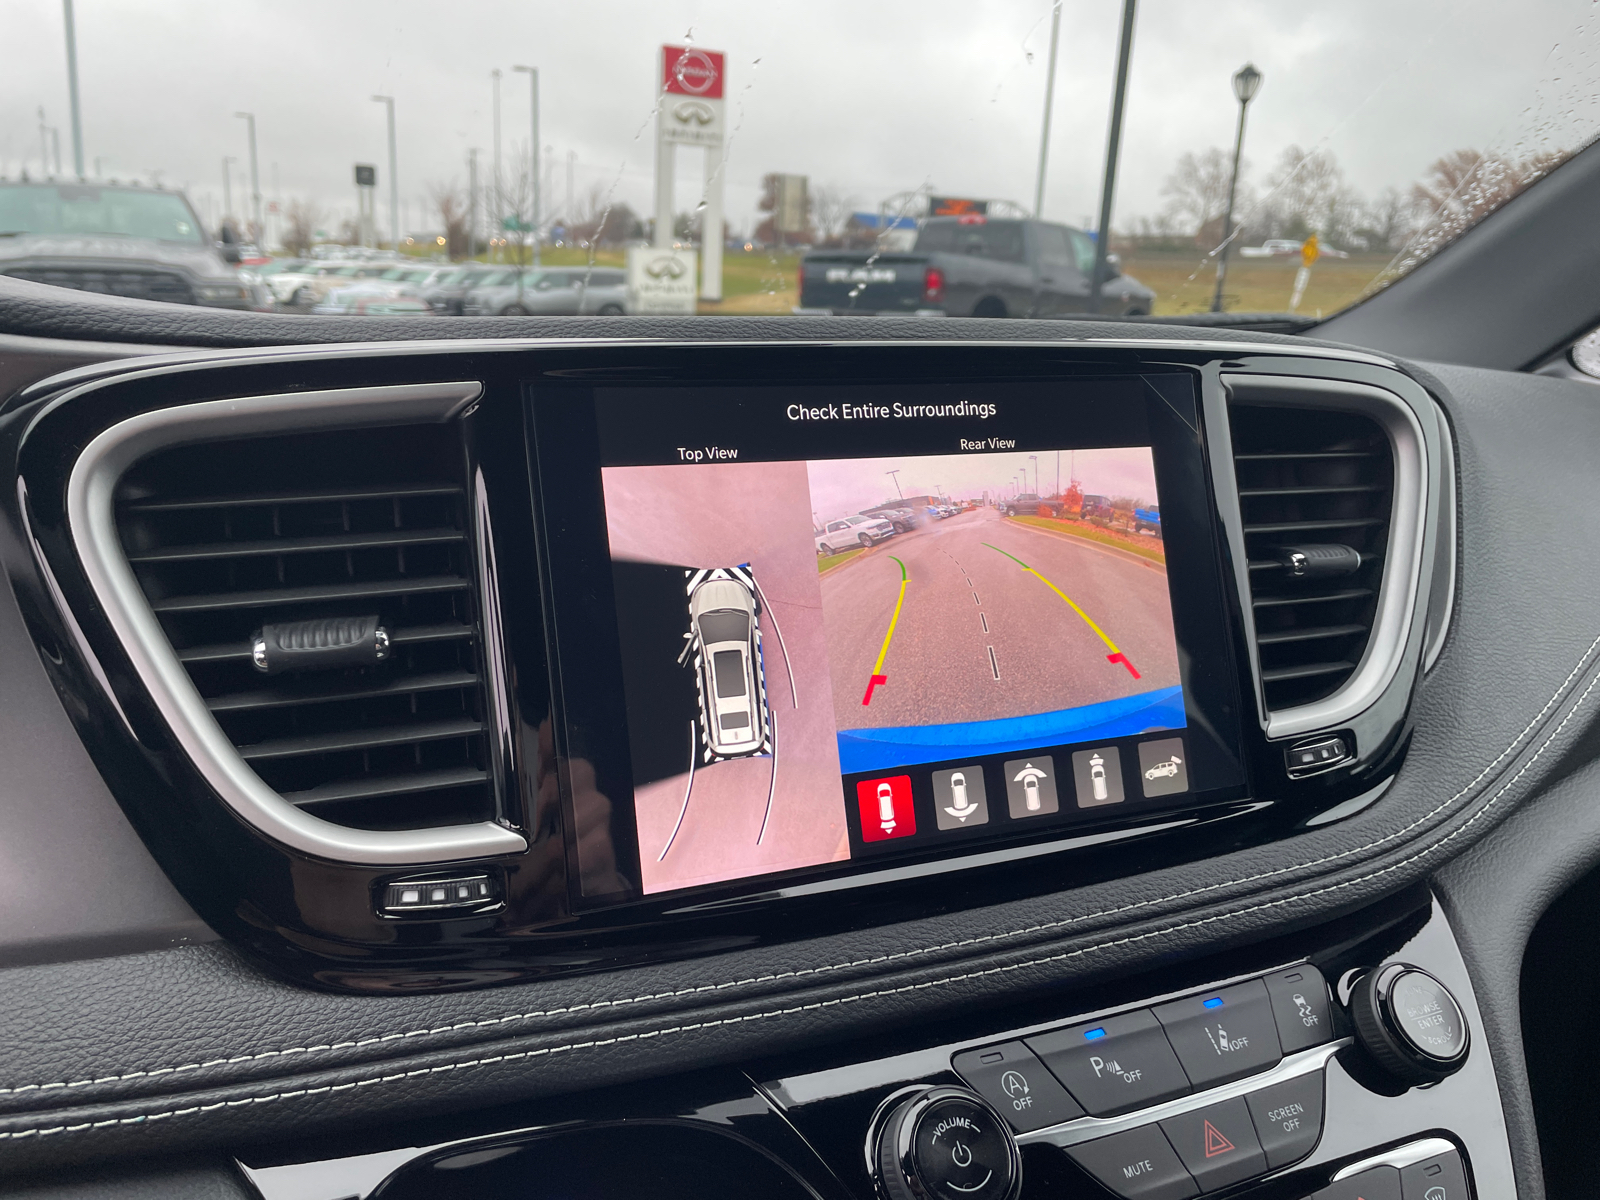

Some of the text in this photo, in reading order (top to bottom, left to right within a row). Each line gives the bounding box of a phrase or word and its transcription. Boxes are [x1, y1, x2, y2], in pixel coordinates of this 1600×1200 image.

[787, 400, 997, 420] Check Entire Surroundings
[960, 437, 1016, 450] Rear View
[677, 446, 738, 462] Top View
[1406, 1000, 1442, 1018] BROWSE
[1302, 1014, 1319, 1028] OFF
[1417, 1014, 1445, 1030] ENTER
[1230, 1036, 1250, 1051] OFF
[1427, 1031, 1453, 1046] SCROLL
[1089, 1056, 1143, 1084] P OFF
[1012, 1096, 1033, 1112] OFF
[1268, 1102, 1304, 1122] SCREEN
[932, 1116, 971, 1137] VOLUME
[1282, 1118, 1301, 1133] OFF
[1122, 1159, 1154, 1179] MUTE
